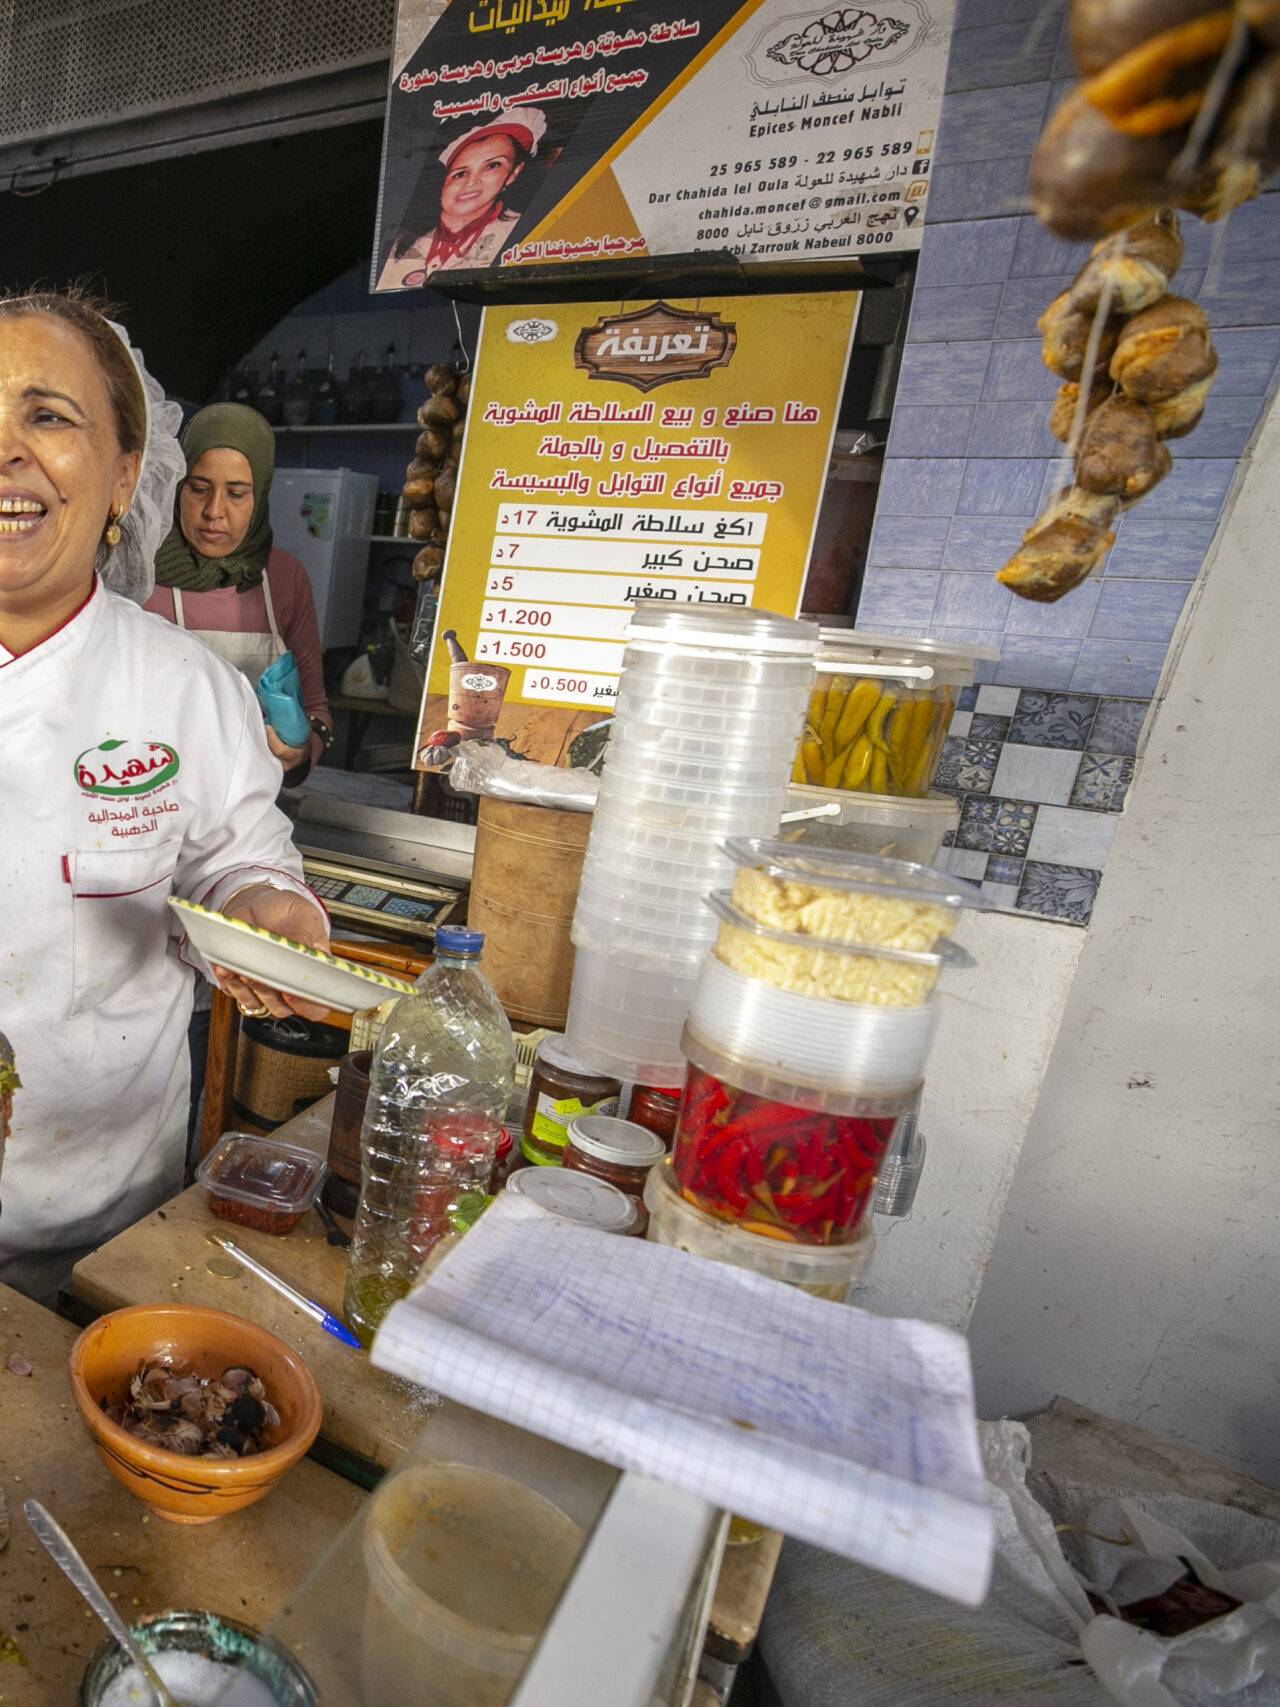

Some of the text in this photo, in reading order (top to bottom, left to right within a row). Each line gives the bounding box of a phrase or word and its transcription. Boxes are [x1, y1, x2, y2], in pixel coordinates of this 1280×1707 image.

[648, 18, 700, 43] سلاطة
[495, 52, 534, 79] عربي
[568, 67, 606, 97] أنواع
[604, 69, 649, 93] جميع
[502, 77, 569, 113] الكسكسي
[749, 78, 907, 121] توابل منصف النابلي
[749, 103, 903, 138] Epices Moncef Nabli
[710, 164, 727, 177] 25
[734, 160, 762, 174] 965
[768, 156, 798, 170] 589
[816, 151, 836, 165] 22
[843, 146, 873, 161] 965
[881, 141, 913, 156] 589
[794, 165, 908, 191] دار شهيدة للعولة
[648, 191, 671, 205] Dar
[676, 184, 728, 201] Chahida
[758, 178, 789, 193] Oula
[814, 212, 861, 234] العربي
[866, 207, 898, 228] نهج
[696, 227, 729, 241] 8000
[736, 223, 763, 239] نابل
[750, 240, 800, 255] Zarrouk
[804, 235, 851, 250] Nabeul
[856, 231, 894, 246] 8000
[501, 241, 544, 267] الكرام
[544, 237, 602, 258] بضيوفنا
[596, 326, 710, 362] تعريفة
[483, 399, 819, 427] هنا صنع و بيع السلاطة المشوية
[538, 436, 729, 462] بالتفصيل و بالجملة
[490, 469, 782, 501] جميع أنواع التوابل والبسيسة
[513, 510, 538, 526] 17
[546, 509, 622, 532] المشوية
[632, 514, 703, 534] سلاطة
[509, 544, 520, 558] 7
[641, 549, 683, 570] كبير
[693, 551, 753, 571] صحن
[502, 577, 513, 591] 5
[498, 610, 552, 627] 1.200
[492, 641, 546, 659] 1.500
[540, 677, 587, 693] 0.500
[78, 744, 174, 788] شهيدة
[88, 799, 179, 824] صاحبة الميدالية
[111, 819, 158, 838] الذهبية
